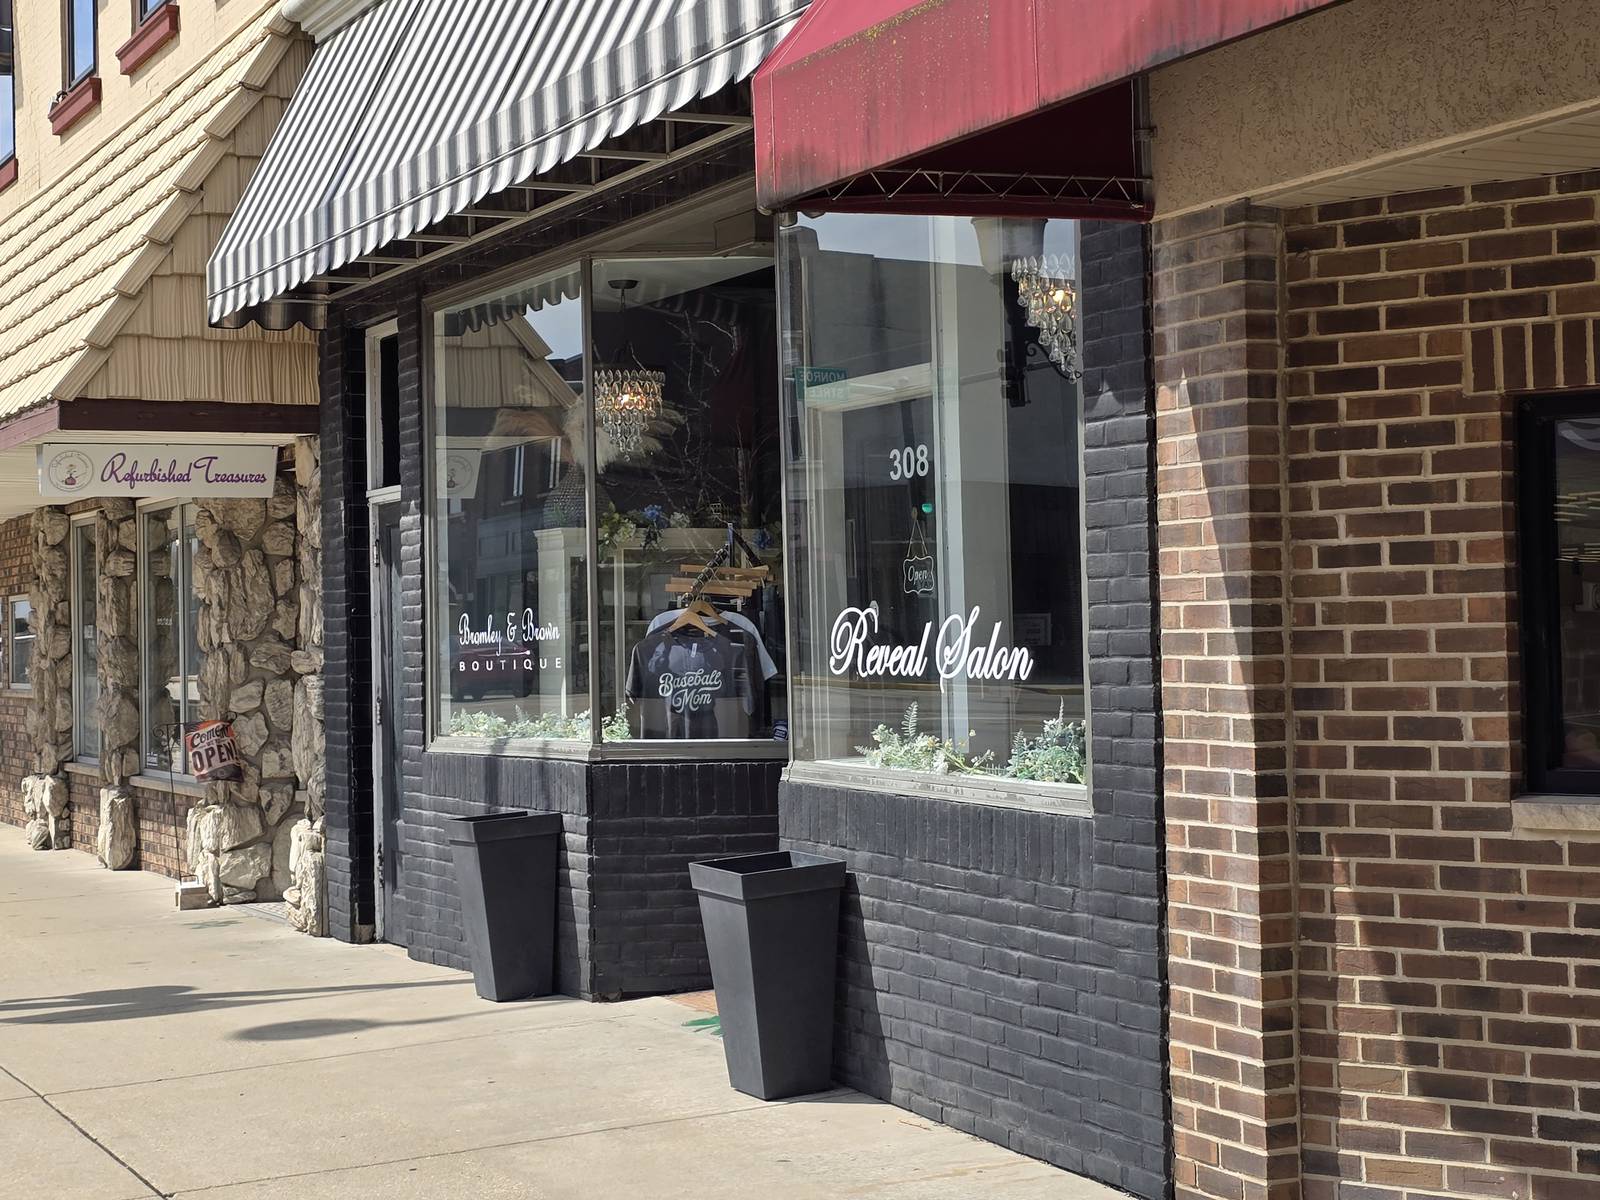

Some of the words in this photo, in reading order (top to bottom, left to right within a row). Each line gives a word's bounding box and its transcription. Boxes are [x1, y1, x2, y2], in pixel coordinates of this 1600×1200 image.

[100, 452, 193, 490] Refurbished
[193, 456, 267, 484] Treasures
[889, 444, 929, 481] 308
[907, 565, 928, 586] Open
[458, 612, 503, 657] Bromley
[506, 612, 518, 642] &
[521, 607, 560, 642] Brown
[459, 657, 562, 672] BOUTIQUE
[829, 606, 932, 678] Reveal
[935, 605, 1034, 694] Salon
[658, 668, 723, 697] Baseball
[672, 687, 713, 714] Mom
